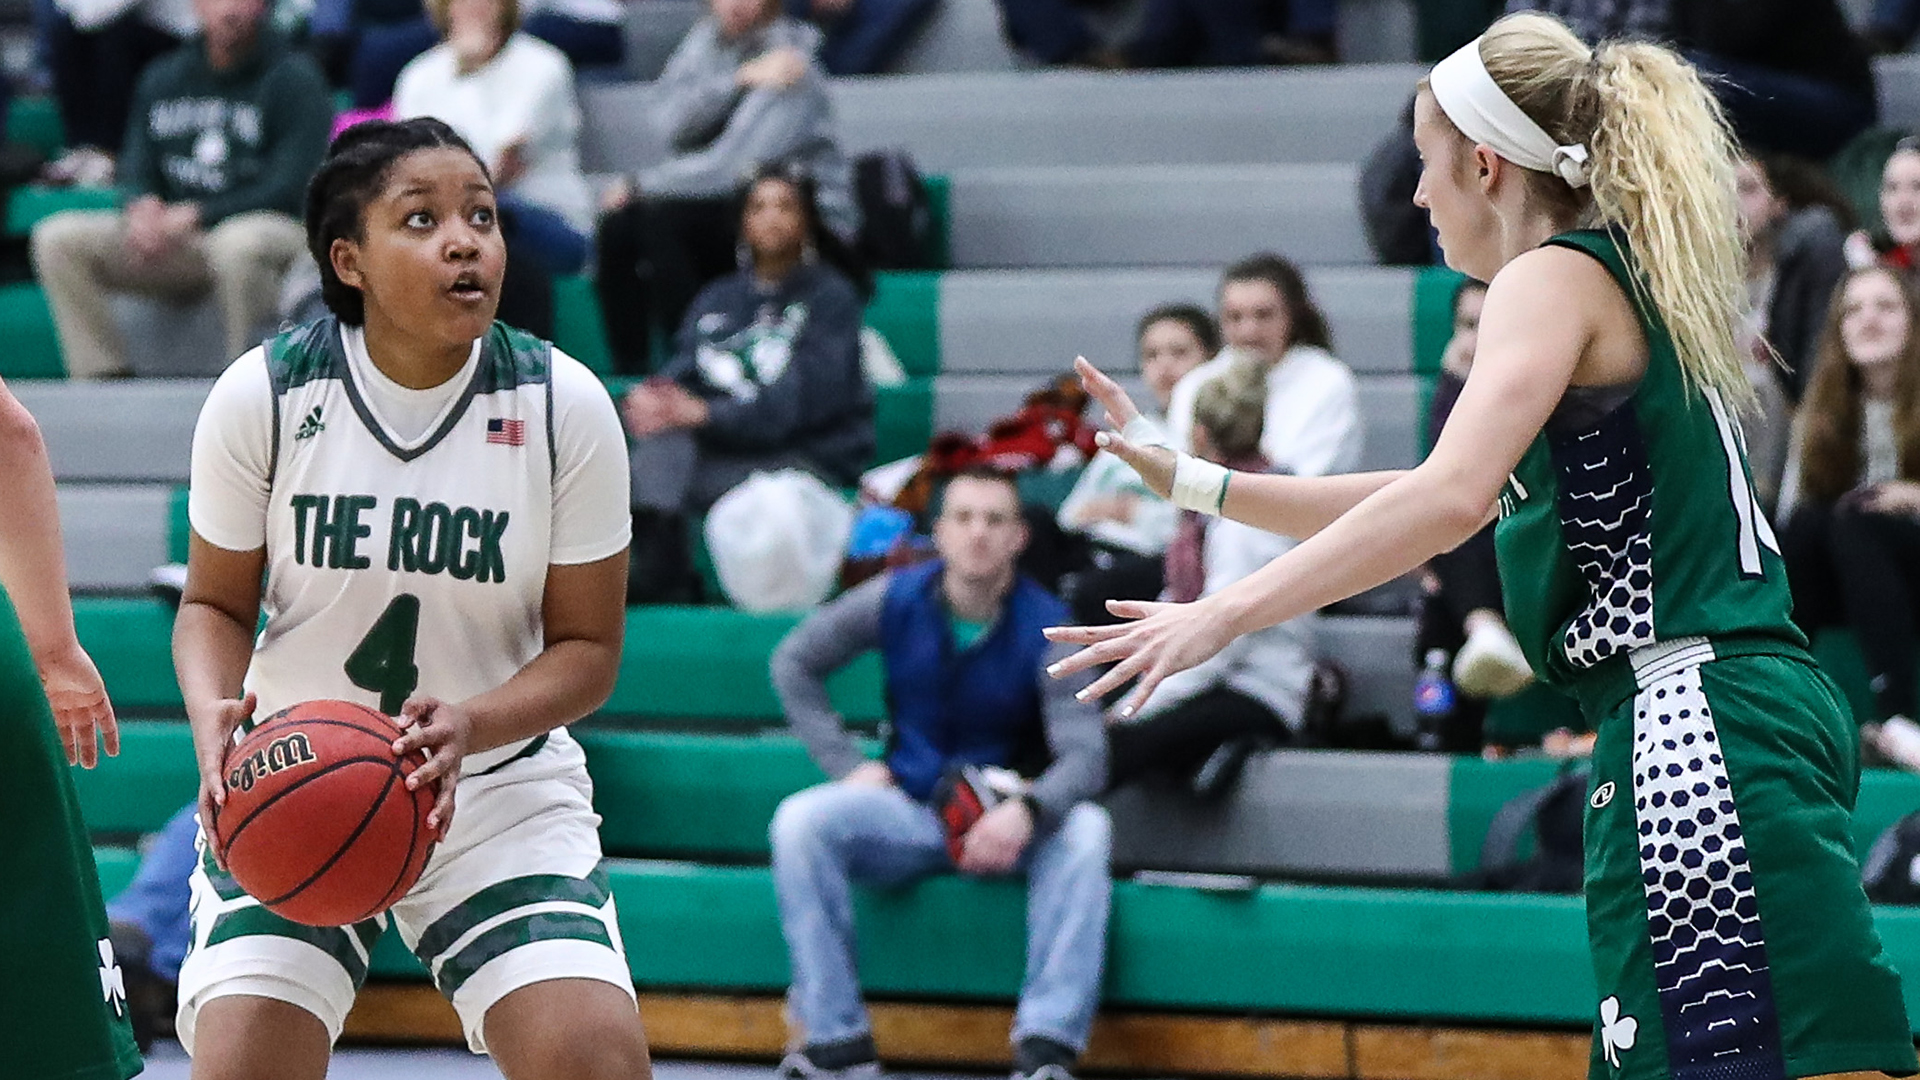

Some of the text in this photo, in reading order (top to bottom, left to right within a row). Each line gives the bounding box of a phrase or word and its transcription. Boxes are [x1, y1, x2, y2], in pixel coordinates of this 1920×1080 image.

[290, 494, 509, 583] THE ROCK
[343, 593, 420, 717] 4
